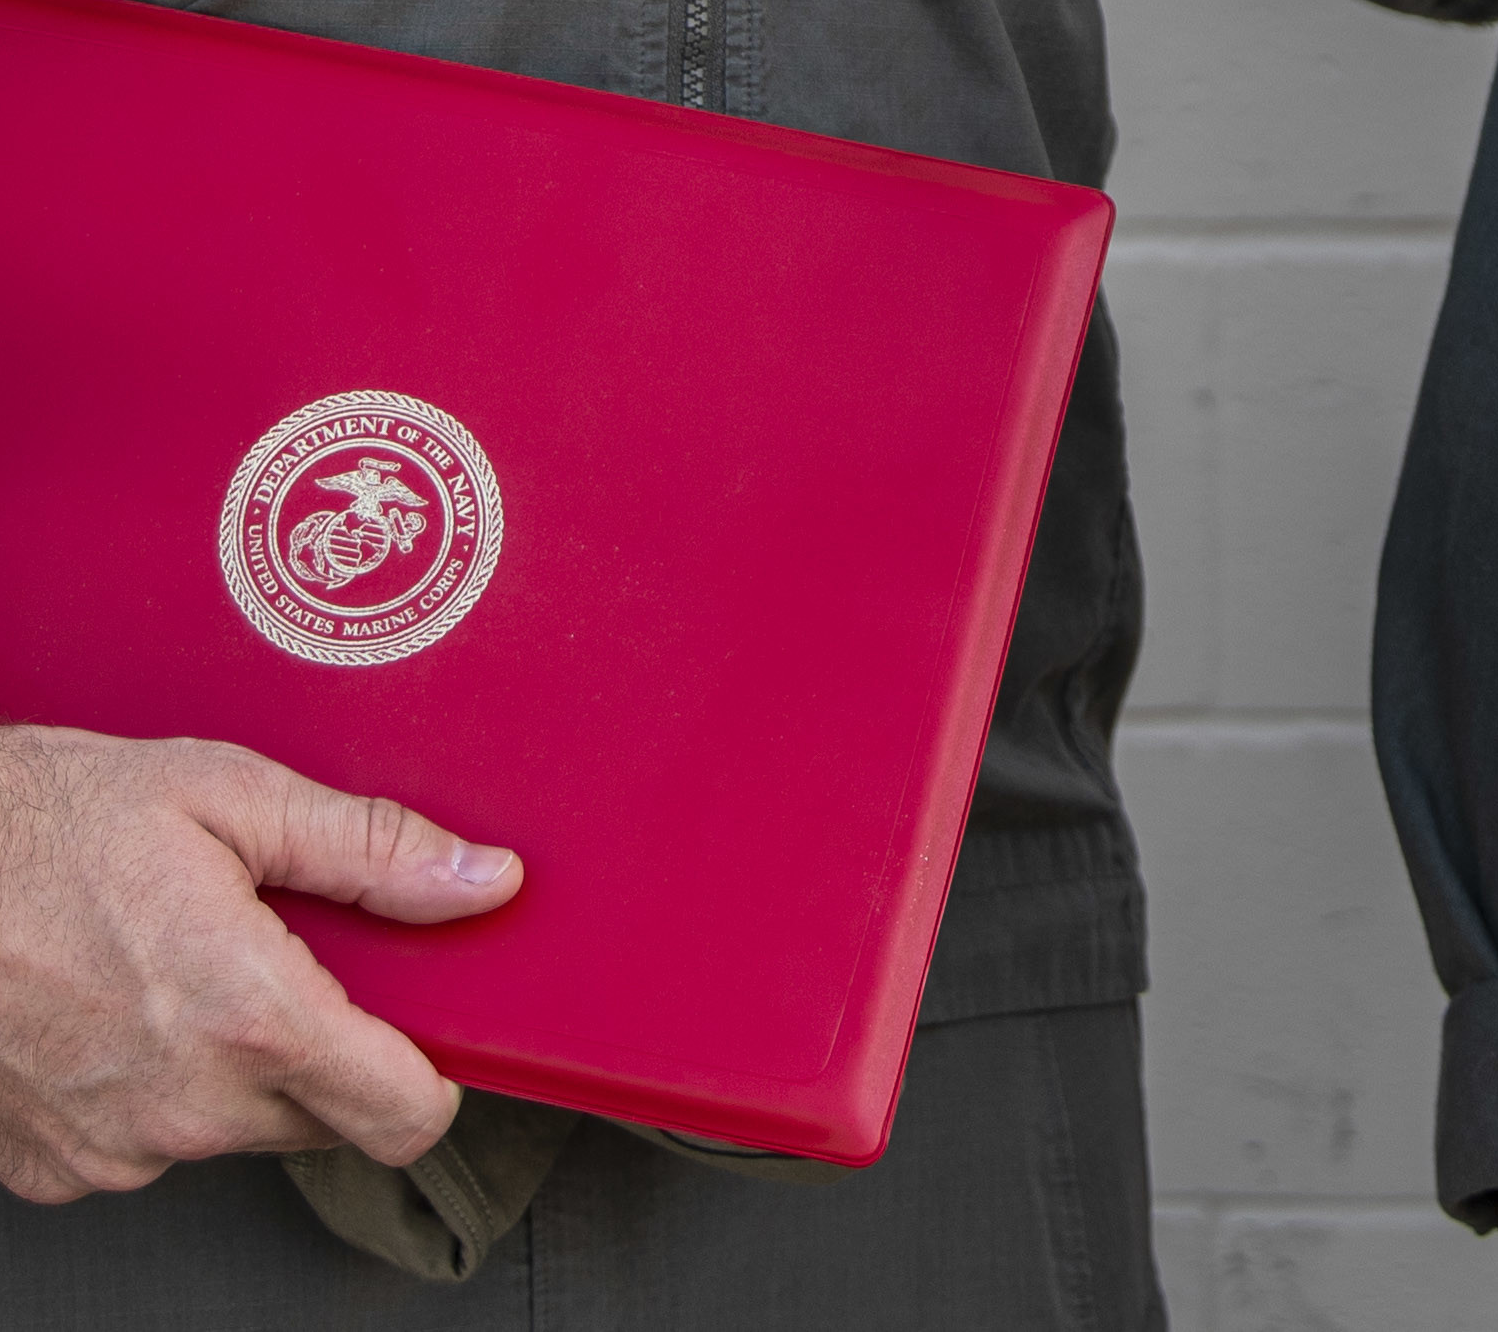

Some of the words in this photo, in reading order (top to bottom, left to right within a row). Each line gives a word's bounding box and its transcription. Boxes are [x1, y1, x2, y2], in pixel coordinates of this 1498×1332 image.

[254, 417, 395, 505] DEPARTMENT
[398, 425, 423, 444] OF
[422, 437, 455, 470] THE
[448, 472, 476, 538] NAVY
[248, 523, 279, 594] UNITED
[275, 594, 335, 633] STATES
[343, 608, 418, 637] MARINE
[419, 559, 464, 610] CORPS
